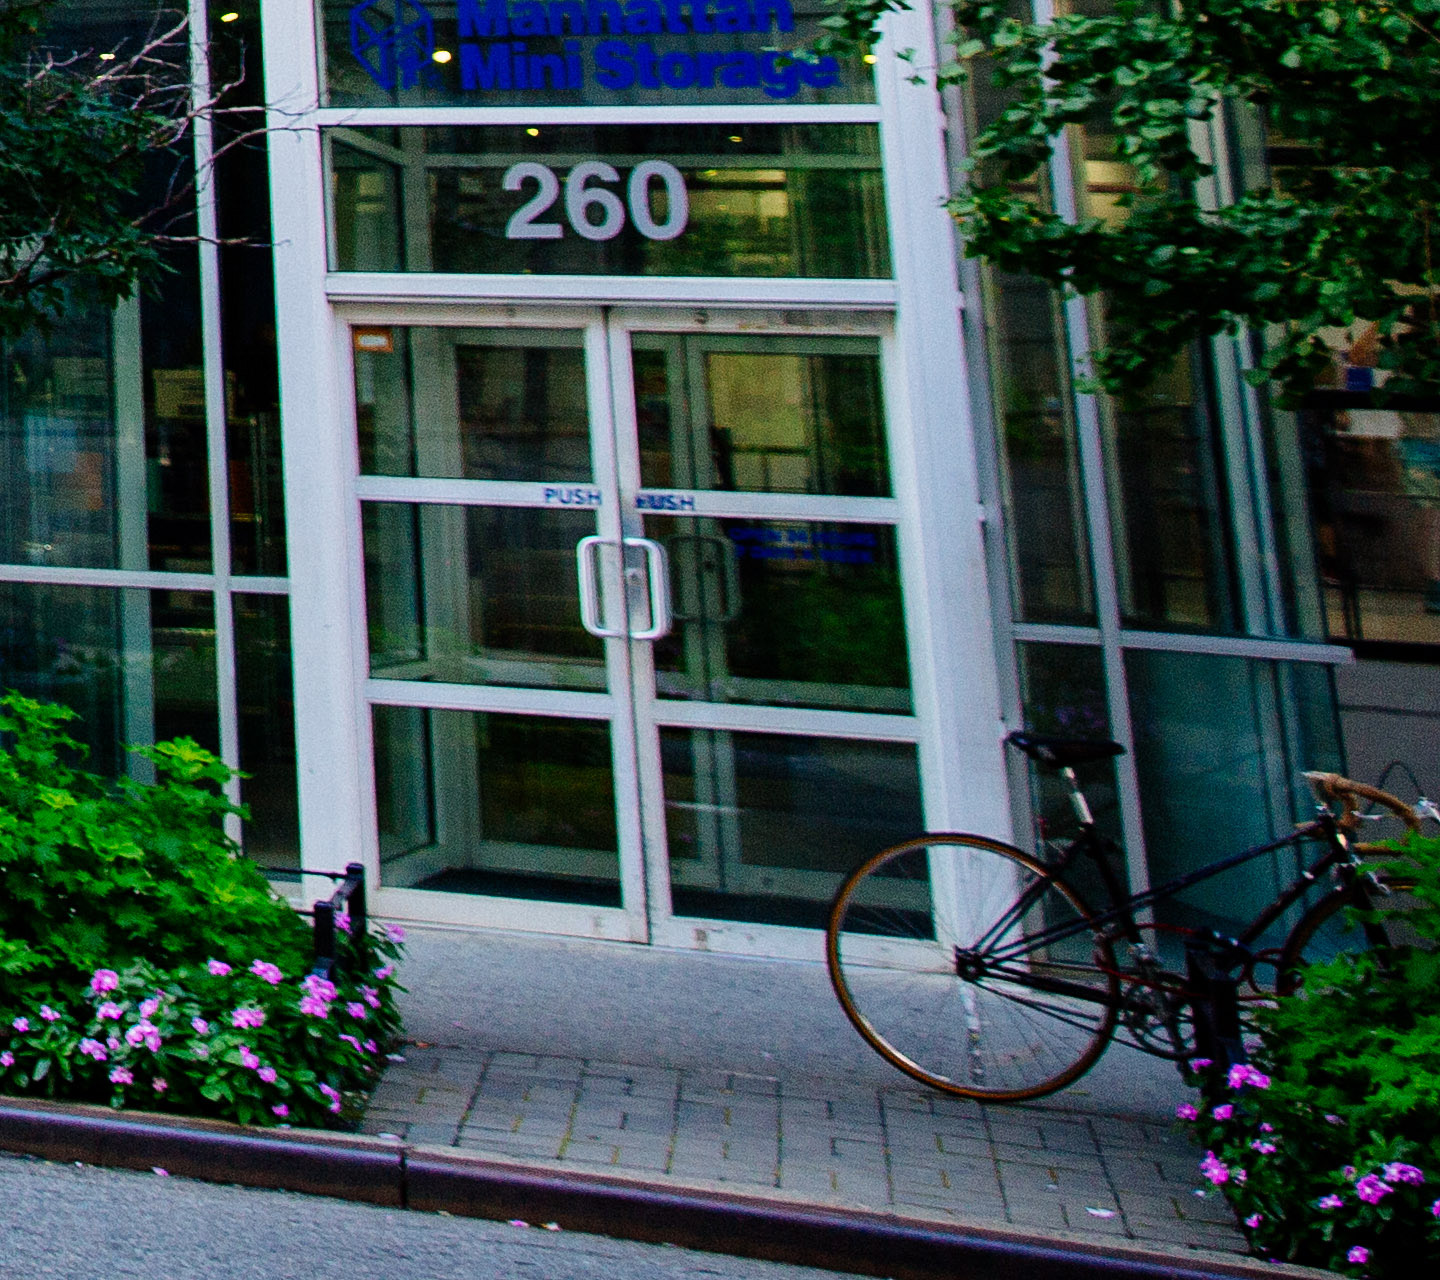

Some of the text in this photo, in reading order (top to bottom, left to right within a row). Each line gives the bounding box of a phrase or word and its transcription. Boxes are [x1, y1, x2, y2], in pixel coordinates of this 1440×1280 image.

[460, 41, 841, 99] Mini Storage
[501, 159, 691, 241] 260
[544, 487, 603, 506] PUSH
[634, 493, 695, 511] PUSH
